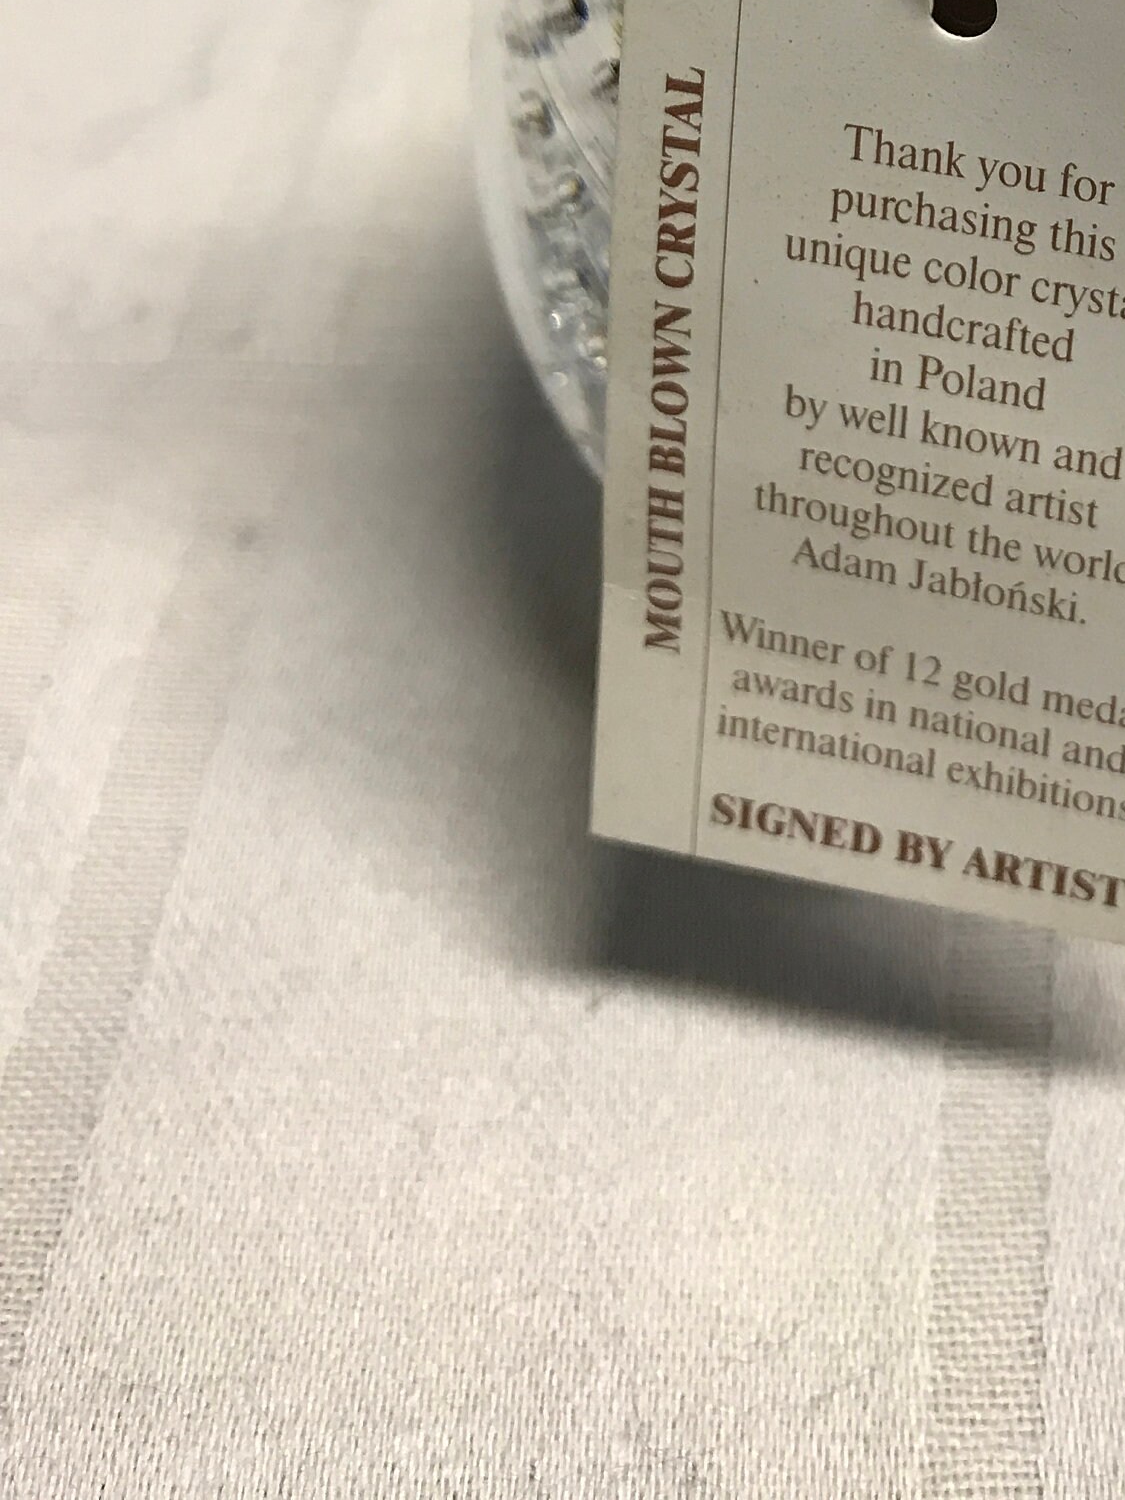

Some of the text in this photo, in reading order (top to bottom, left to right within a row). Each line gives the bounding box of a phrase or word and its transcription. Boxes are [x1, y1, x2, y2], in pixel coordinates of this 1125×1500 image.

[843, 123, 1115, 205] Thank you for
[830, 187, 1116, 262] purchasing this
[785, 233, 911, 280] unique
[924, 256, 1020, 298] color
[644, 67, 707, 654] MOUTH BLOWN CRYSTAL
[852, 290, 1074, 362] handcrafted
[869, 347, 1046, 411] in Poland
[785, 384, 1122, 480] by well known and
[754, 481, 956, 549] throughout
[968, 525, 1021, 562] the
[799, 446, 1099, 529] recognized artist
[792, 535, 1086, 625] Adam Jabłoński.
[721, 609, 845, 664] Winner
[854, 645, 894, 675] of
[906, 651, 941, 686] 12
[953, 671, 1029, 706] gold
[716, 705, 936, 778] international
[732, 668, 854, 713] awards
[865, 689, 896, 723] in
[909, 705, 1050, 757] national
[710, 792, 883, 856] SIGNED
[896, 829, 954, 870] BY
